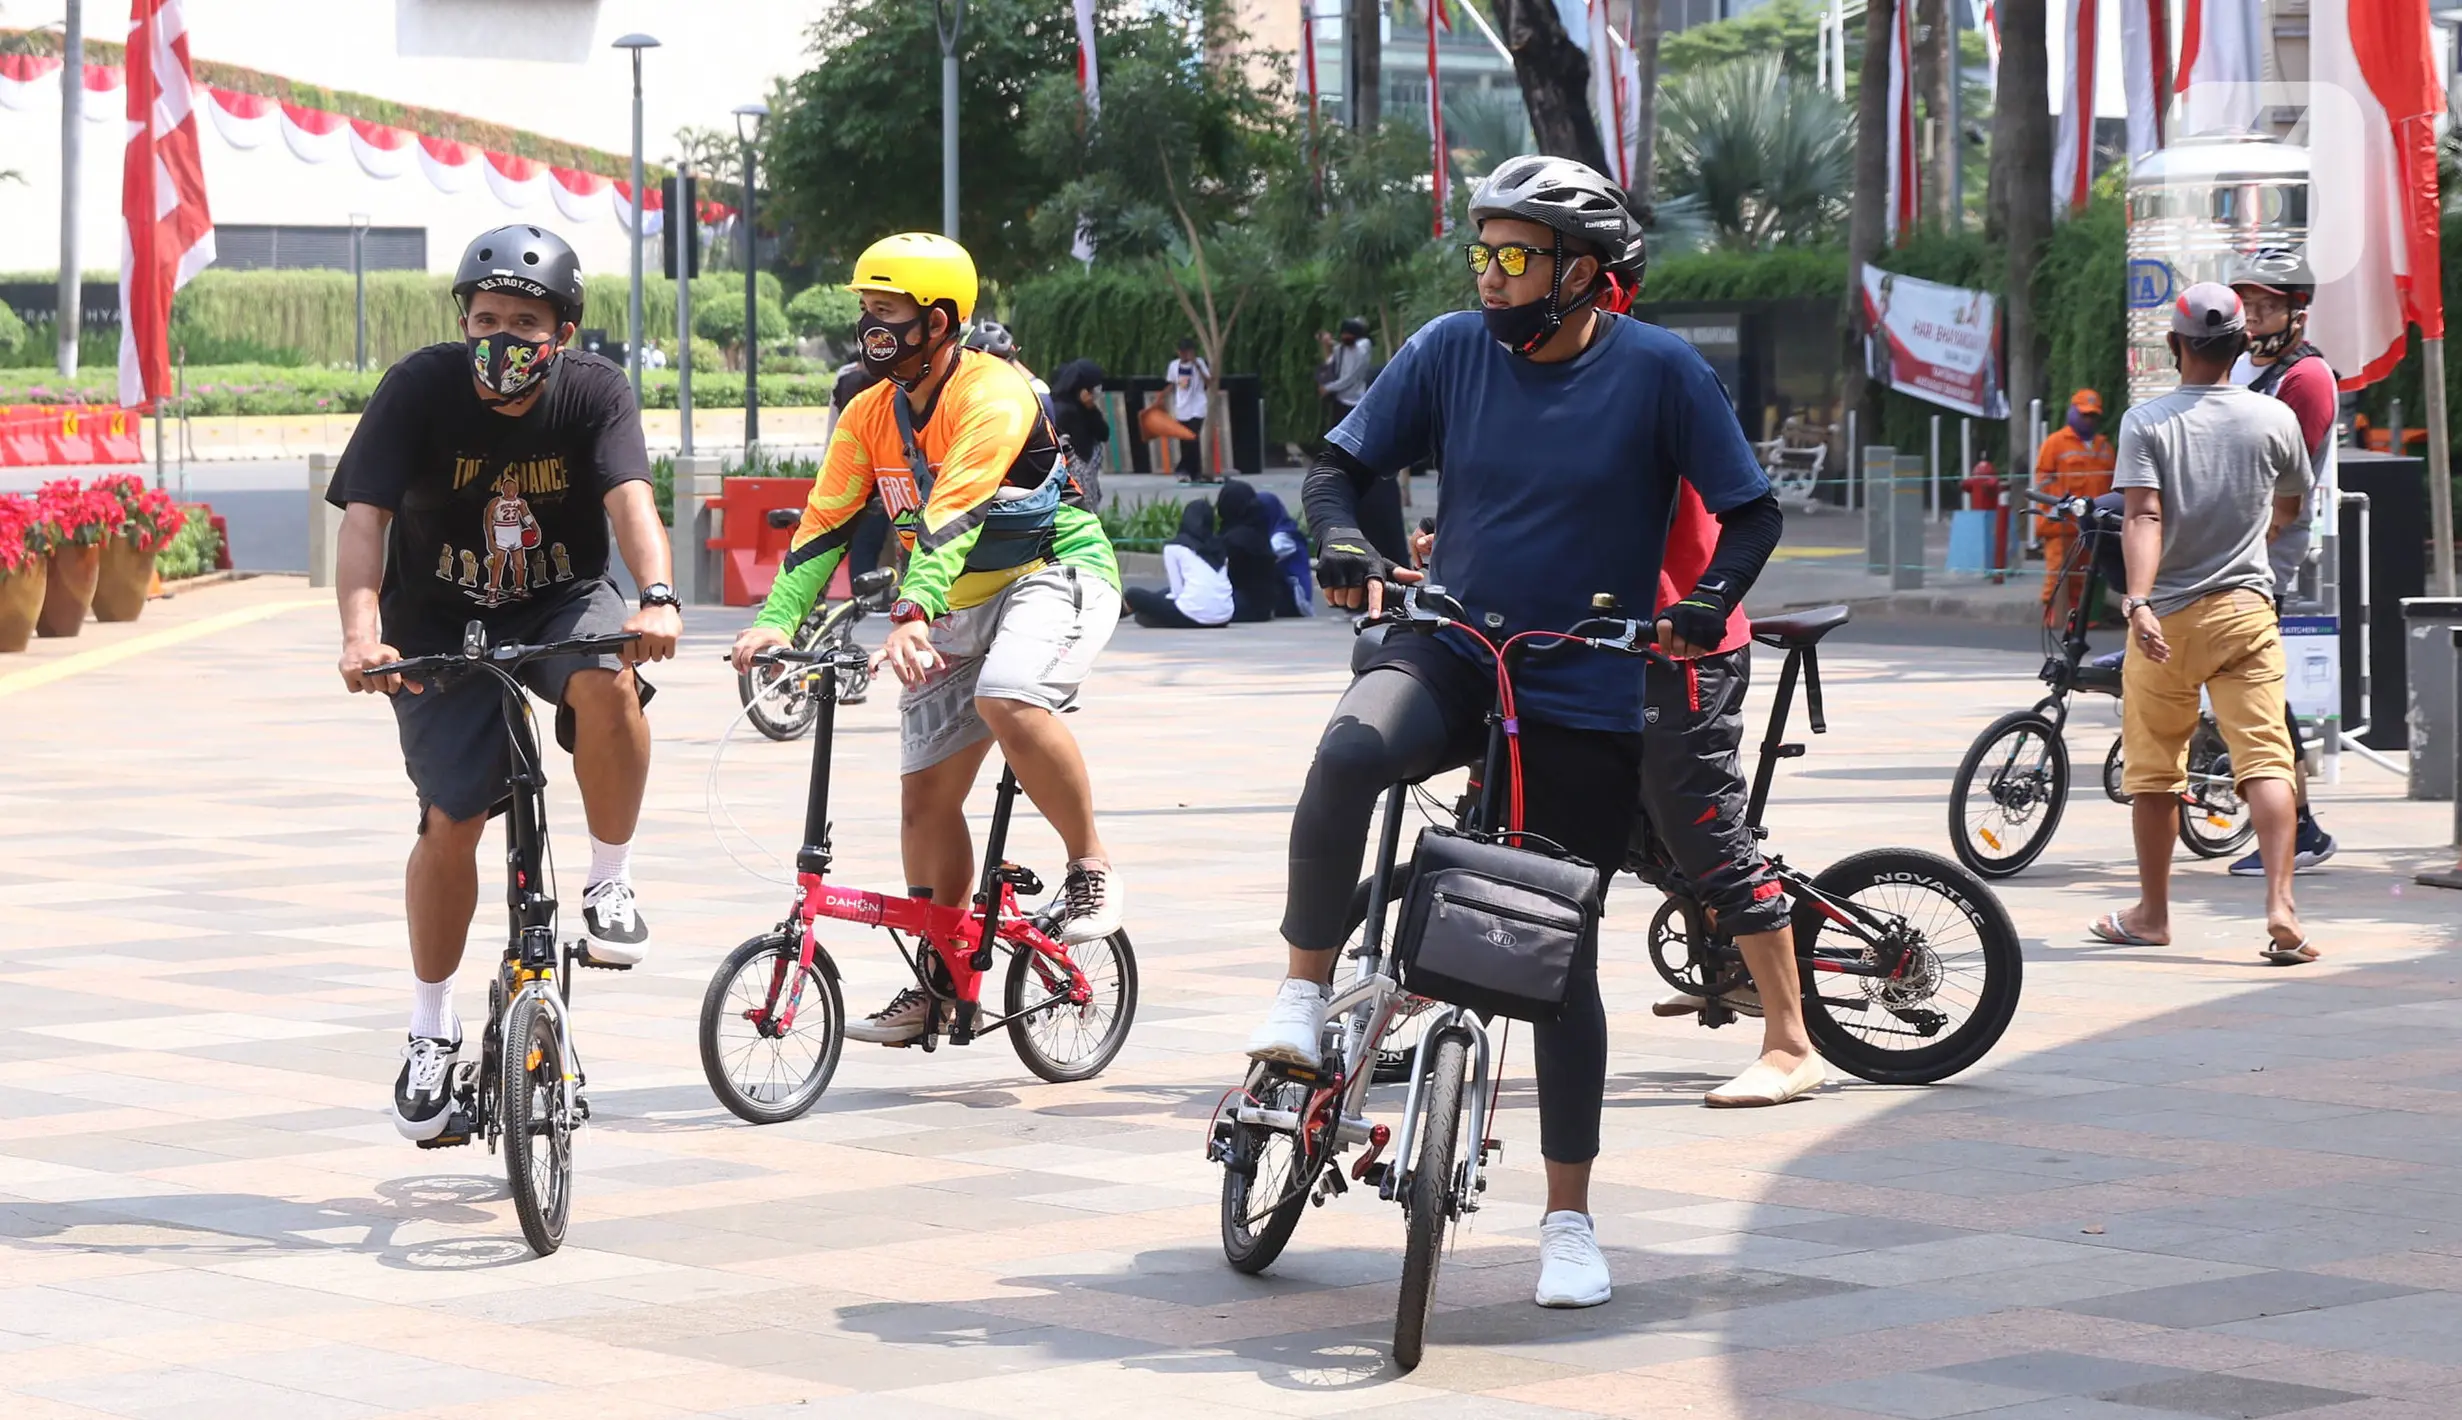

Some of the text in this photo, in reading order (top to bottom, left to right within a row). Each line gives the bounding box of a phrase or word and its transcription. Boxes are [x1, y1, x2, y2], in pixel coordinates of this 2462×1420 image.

[503, 509, 518, 521] 23
[825, 895, 880, 913] DAHON
[1873, 872, 1985, 927] NOVATEC
